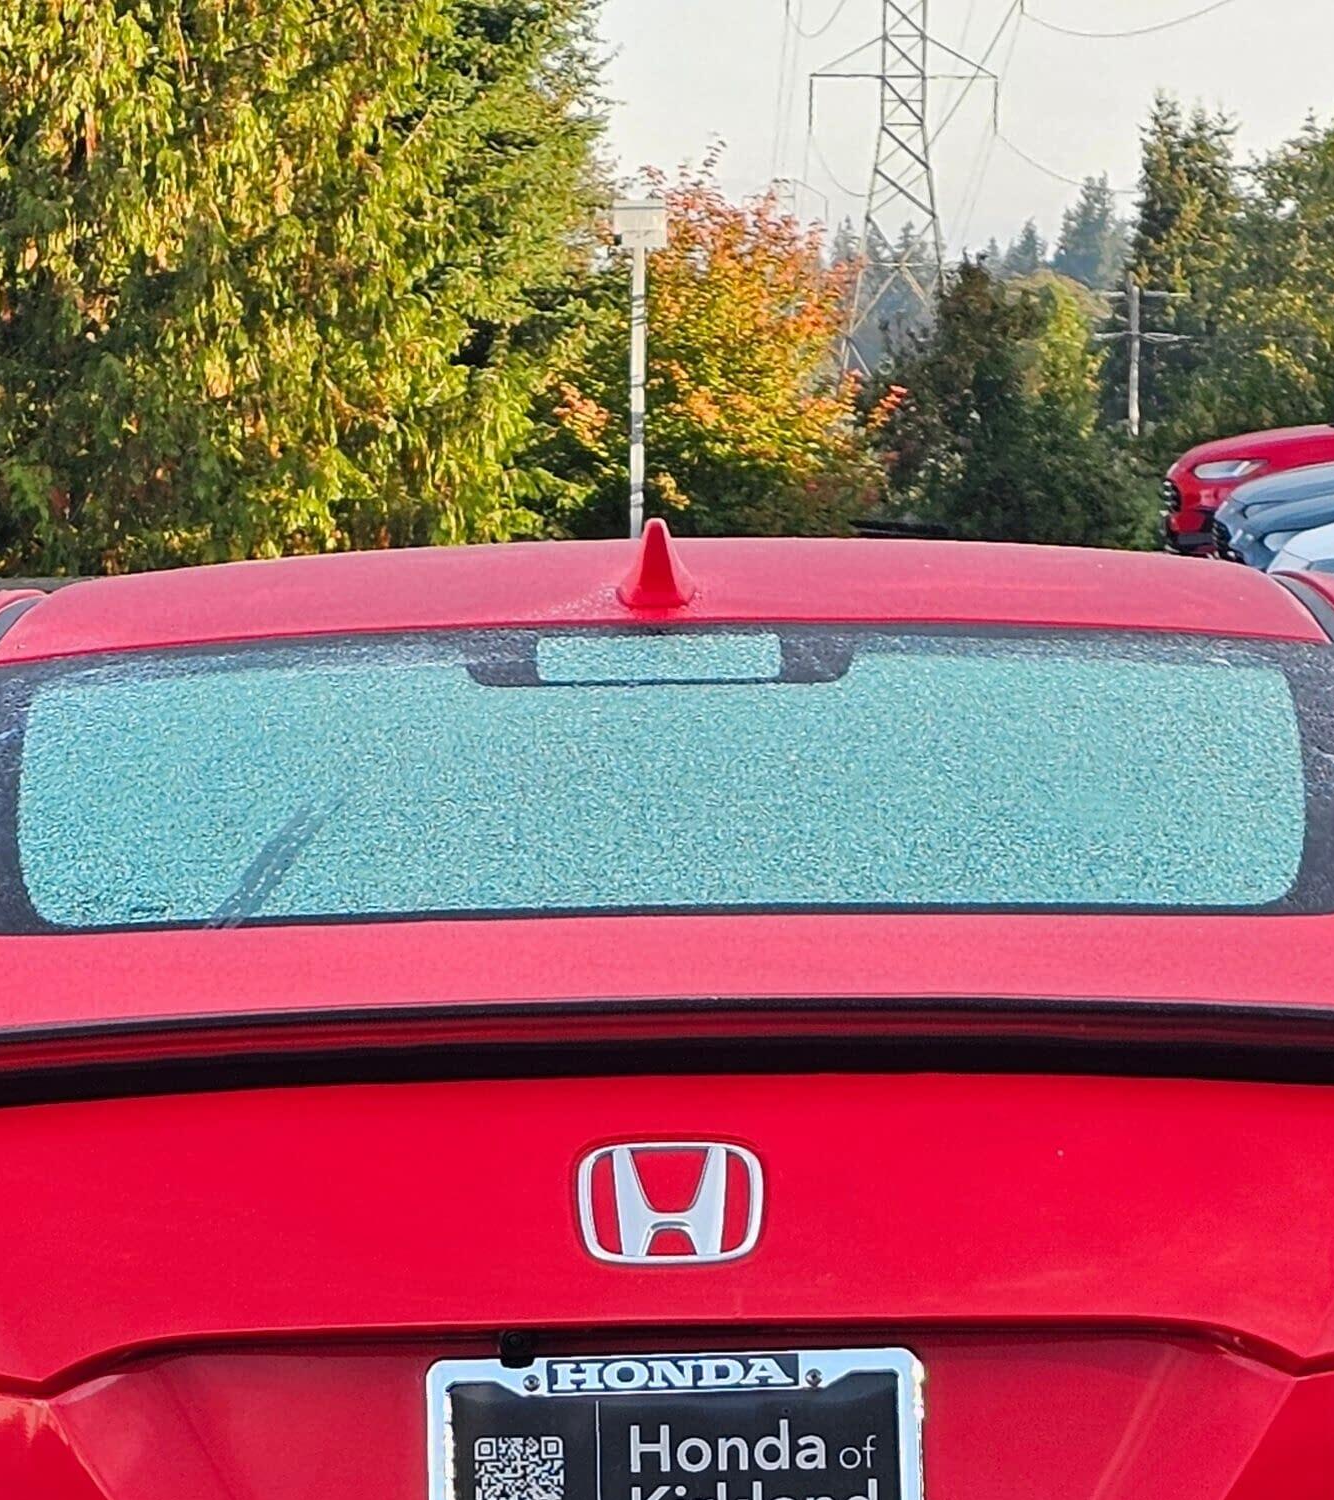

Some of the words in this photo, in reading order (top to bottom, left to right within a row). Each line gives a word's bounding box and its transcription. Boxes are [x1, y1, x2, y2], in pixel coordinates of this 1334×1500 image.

[551, 1358, 795, 1390] HONDA
[629, 1419, 827, 1473] Honda
[839, 1436, 877, 1470] of
